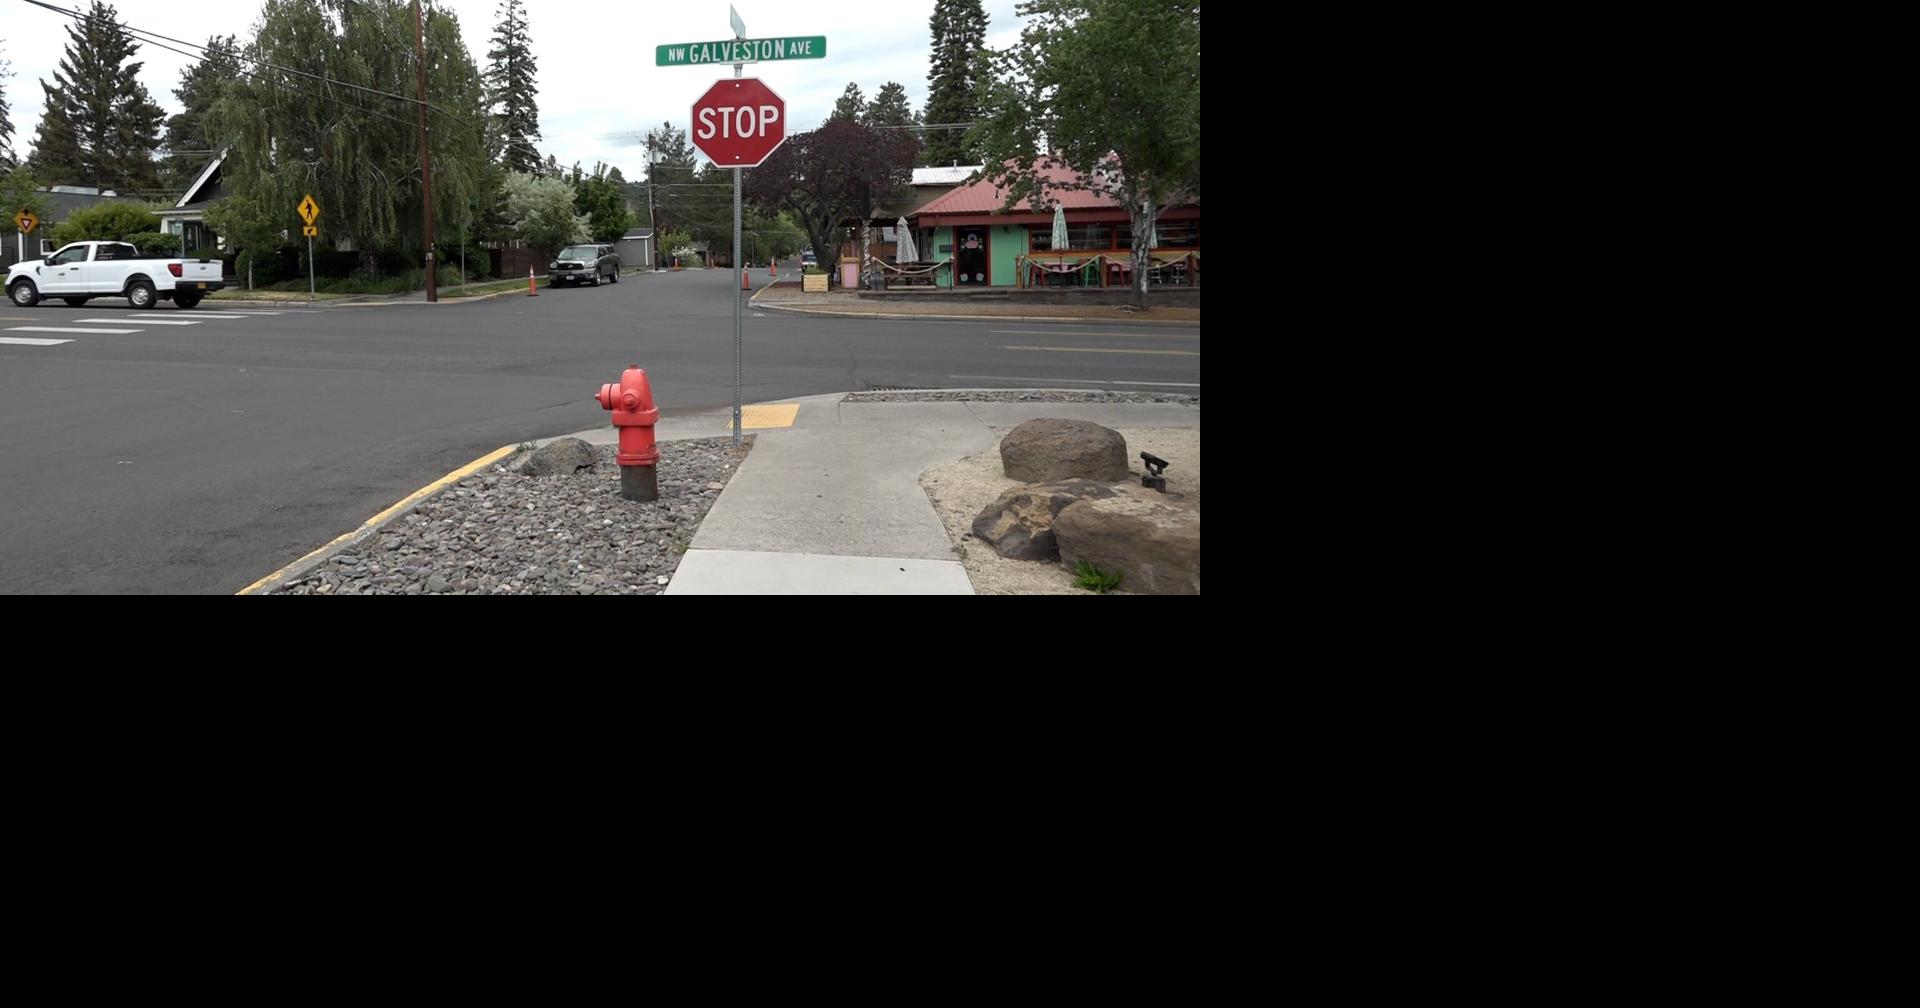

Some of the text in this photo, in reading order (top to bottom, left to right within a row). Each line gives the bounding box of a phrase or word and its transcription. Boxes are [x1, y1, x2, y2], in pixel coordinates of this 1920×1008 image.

[668, 39, 812, 63] NW GALVESTON AVE
[697, 105, 779, 139] STOP
